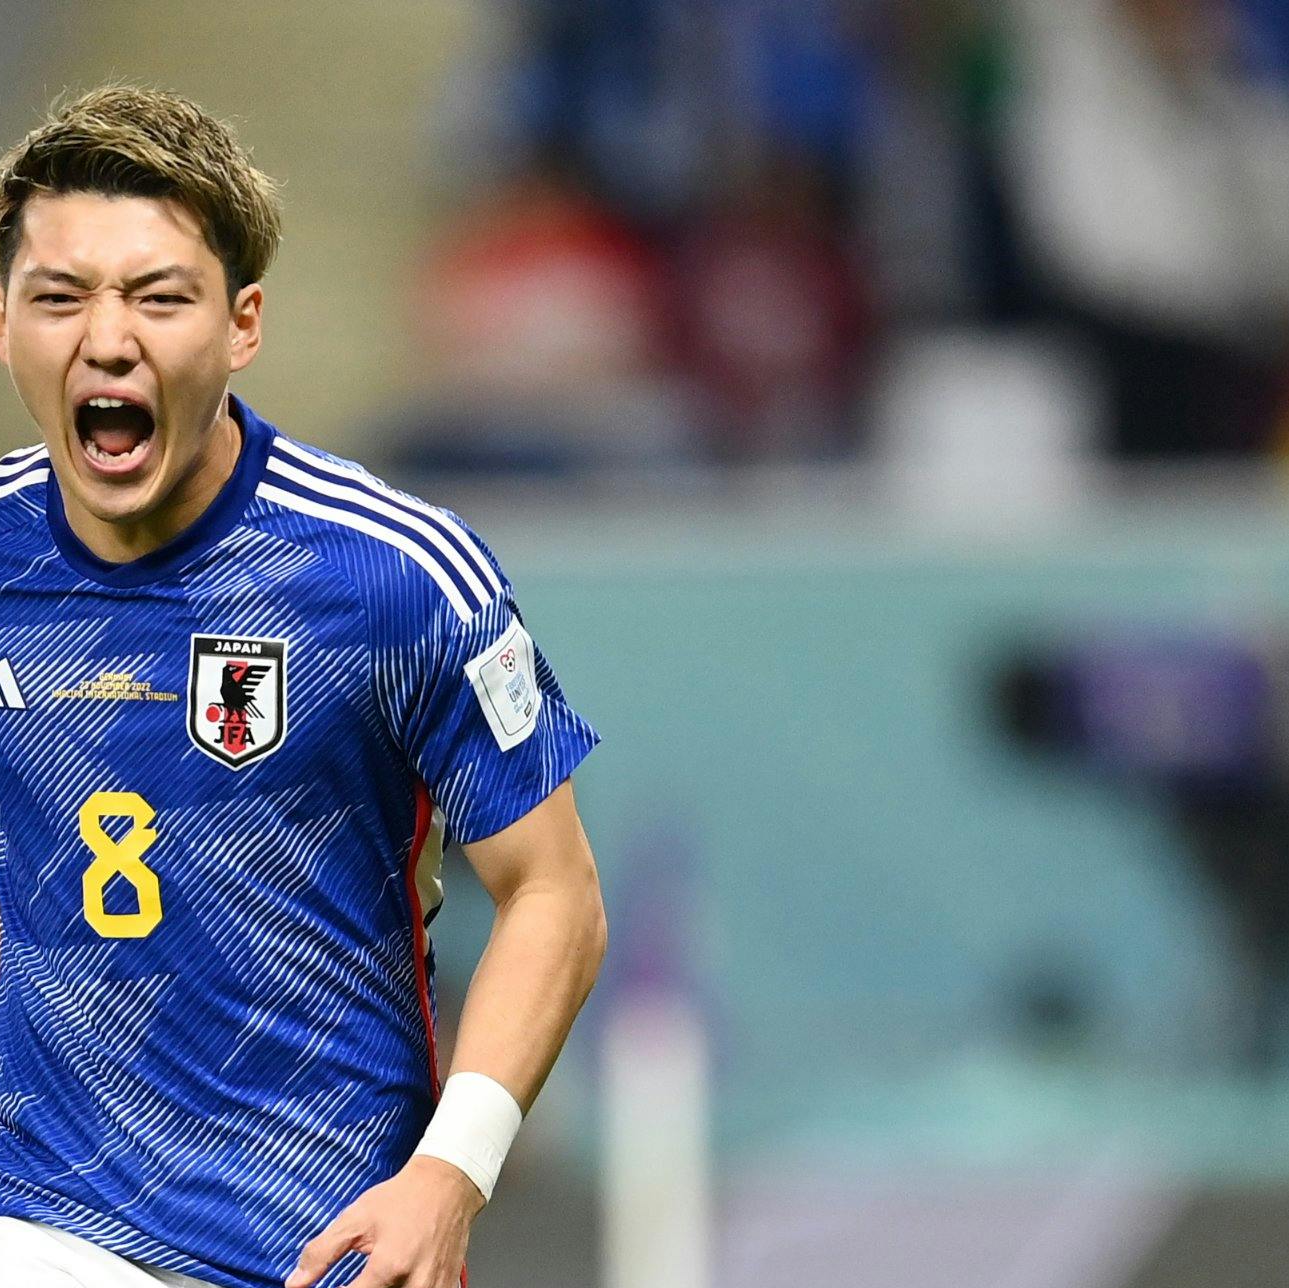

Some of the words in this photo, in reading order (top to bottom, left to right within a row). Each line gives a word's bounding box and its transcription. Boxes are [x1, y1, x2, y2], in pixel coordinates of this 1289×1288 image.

[214, 641, 262, 654] JAPAN
[91, 681, 130, 691] NOVEMBER
[131, 682, 151, 692] 2022
[85, 690, 144, 701] INTERNATIONAL
[145, 691, 178, 702] STADIUM
[213, 725, 255, 745] JFA
[78, 791, 163, 939] 8
